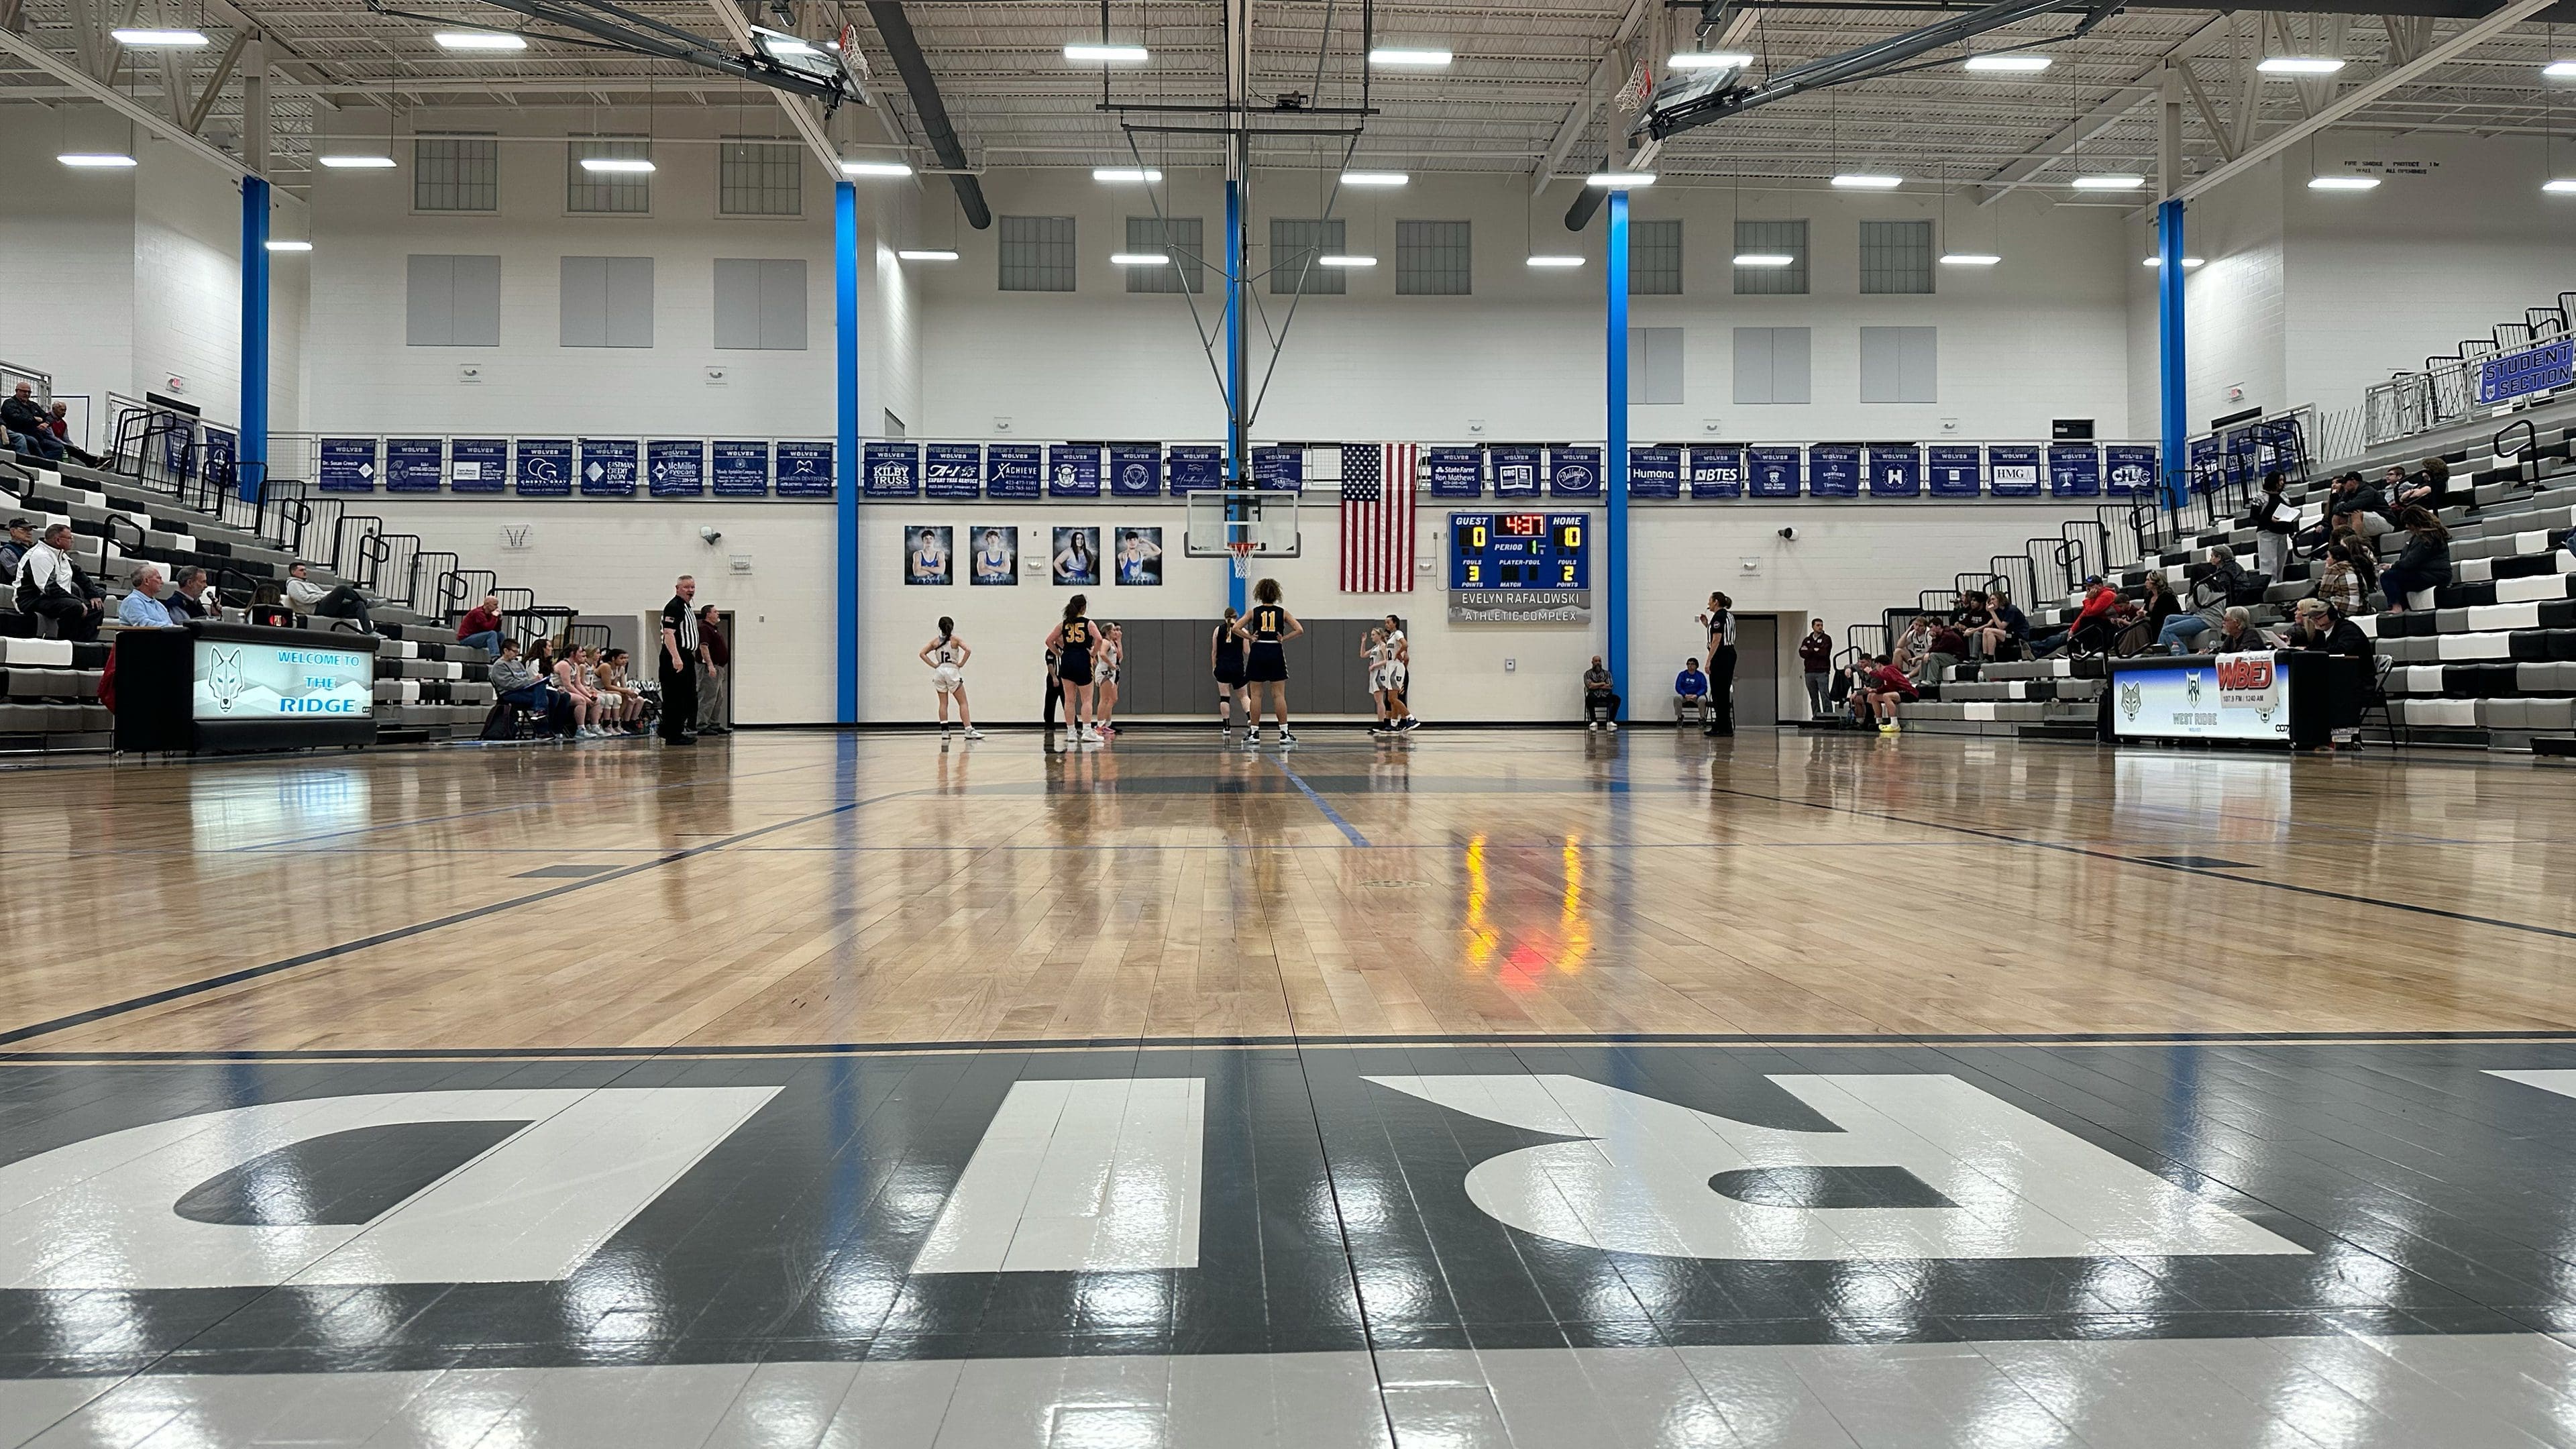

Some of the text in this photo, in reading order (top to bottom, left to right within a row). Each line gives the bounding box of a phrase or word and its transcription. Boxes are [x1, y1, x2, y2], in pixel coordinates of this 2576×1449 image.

[2485, 343, 2571, 381] STUDENT
[2500, 364, 2571, 397] SECTION
[667, 462, 696, 470] McMillin
[873, 467, 910, 476] KILBY
[1006, 467, 1037, 475] ACHIEVE
[874, 476, 910, 484] TRUSS
[1448, 474, 1474, 482] Mathews
[1707, 468, 1737, 481] BTES
[1997, 469, 2024, 478] HMG
[1456, 517, 1488, 525] GUEST
[1506, 516, 1544, 535] 4:37
[1553, 517, 1582, 525] HOME
[1473, 527, 1486, 547] 0
[1532, 539, 1537, 555] 1
[1469, 566, 1479, 581] 3
[1564, 566, 1574, 581] 2
[1462, 593, 1579, 604] EVELYN RAFALOWSKI
[1260, 610, 1276, 632] 11
[1465, 611, 1576, 621] ATHLETIC COMPLEX
[1065, 623, 1085, 643] 35
[278, 650, 360, 667] WELCOME TO
[941, 651, 952, 663] 12
[2217, 657, 2273, 691] WBEJ
[305, 676, 337, 690] THE
[280, 698, 357, 713] RIDGE
[2173, 713, 2218, 726] WEST RIDGE
